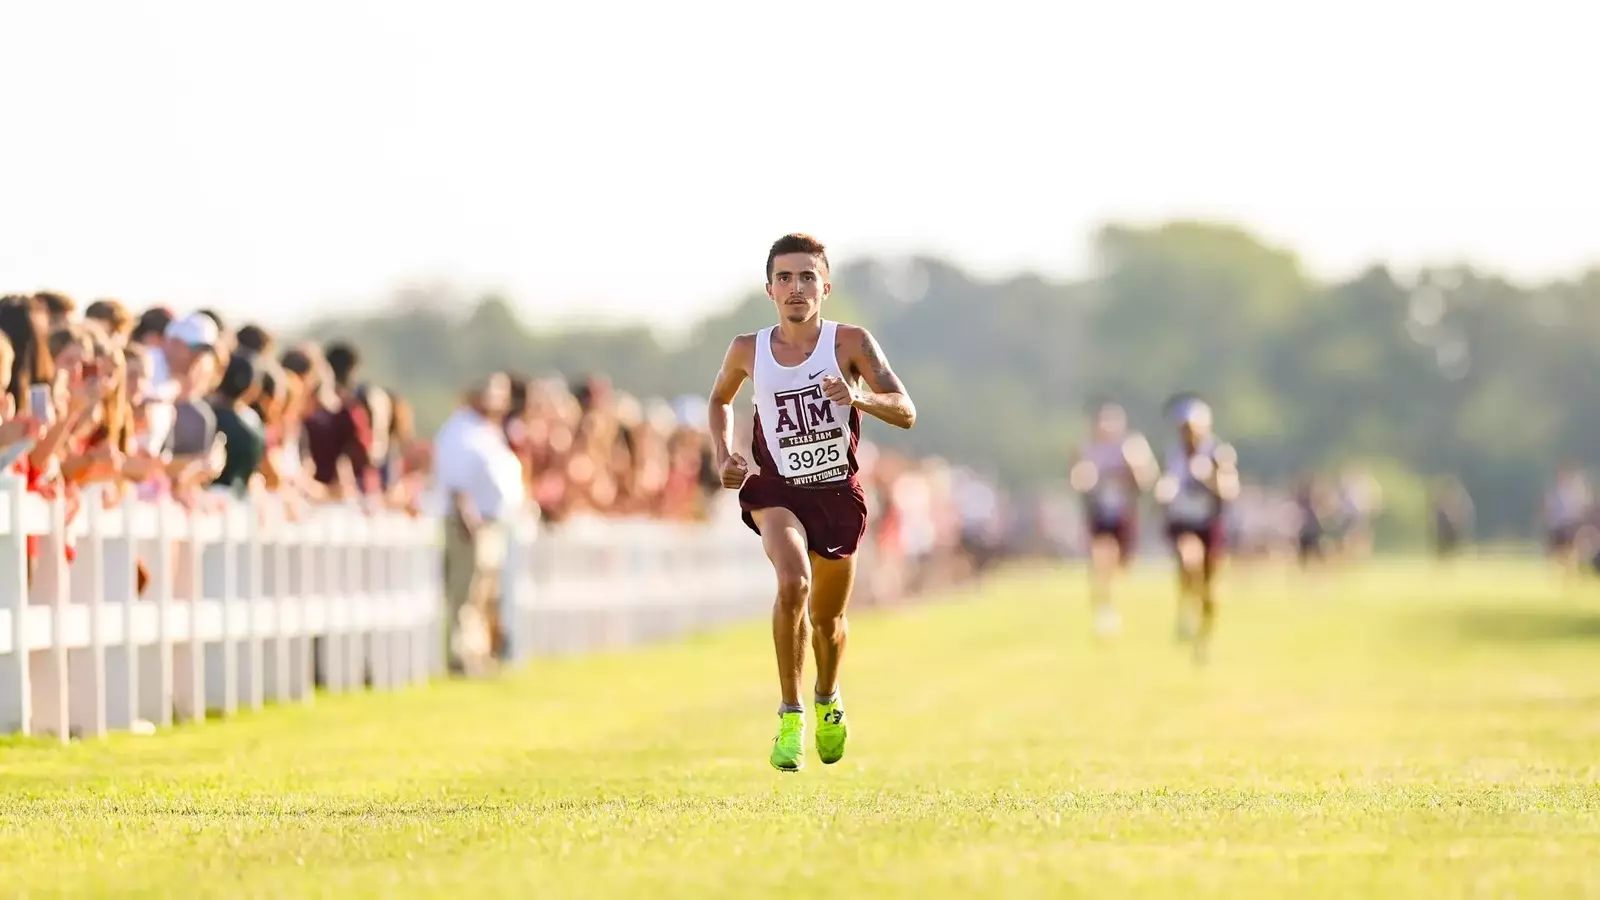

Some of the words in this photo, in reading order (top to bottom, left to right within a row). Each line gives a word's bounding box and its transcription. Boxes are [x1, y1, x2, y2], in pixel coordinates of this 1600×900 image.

[788, 433, 813, 445] TEXAS
[815, 431, 832, 441] A&M
[788, 444, 840, 471] 3925
[793, 467, 842, 485] INVITATIONAL
